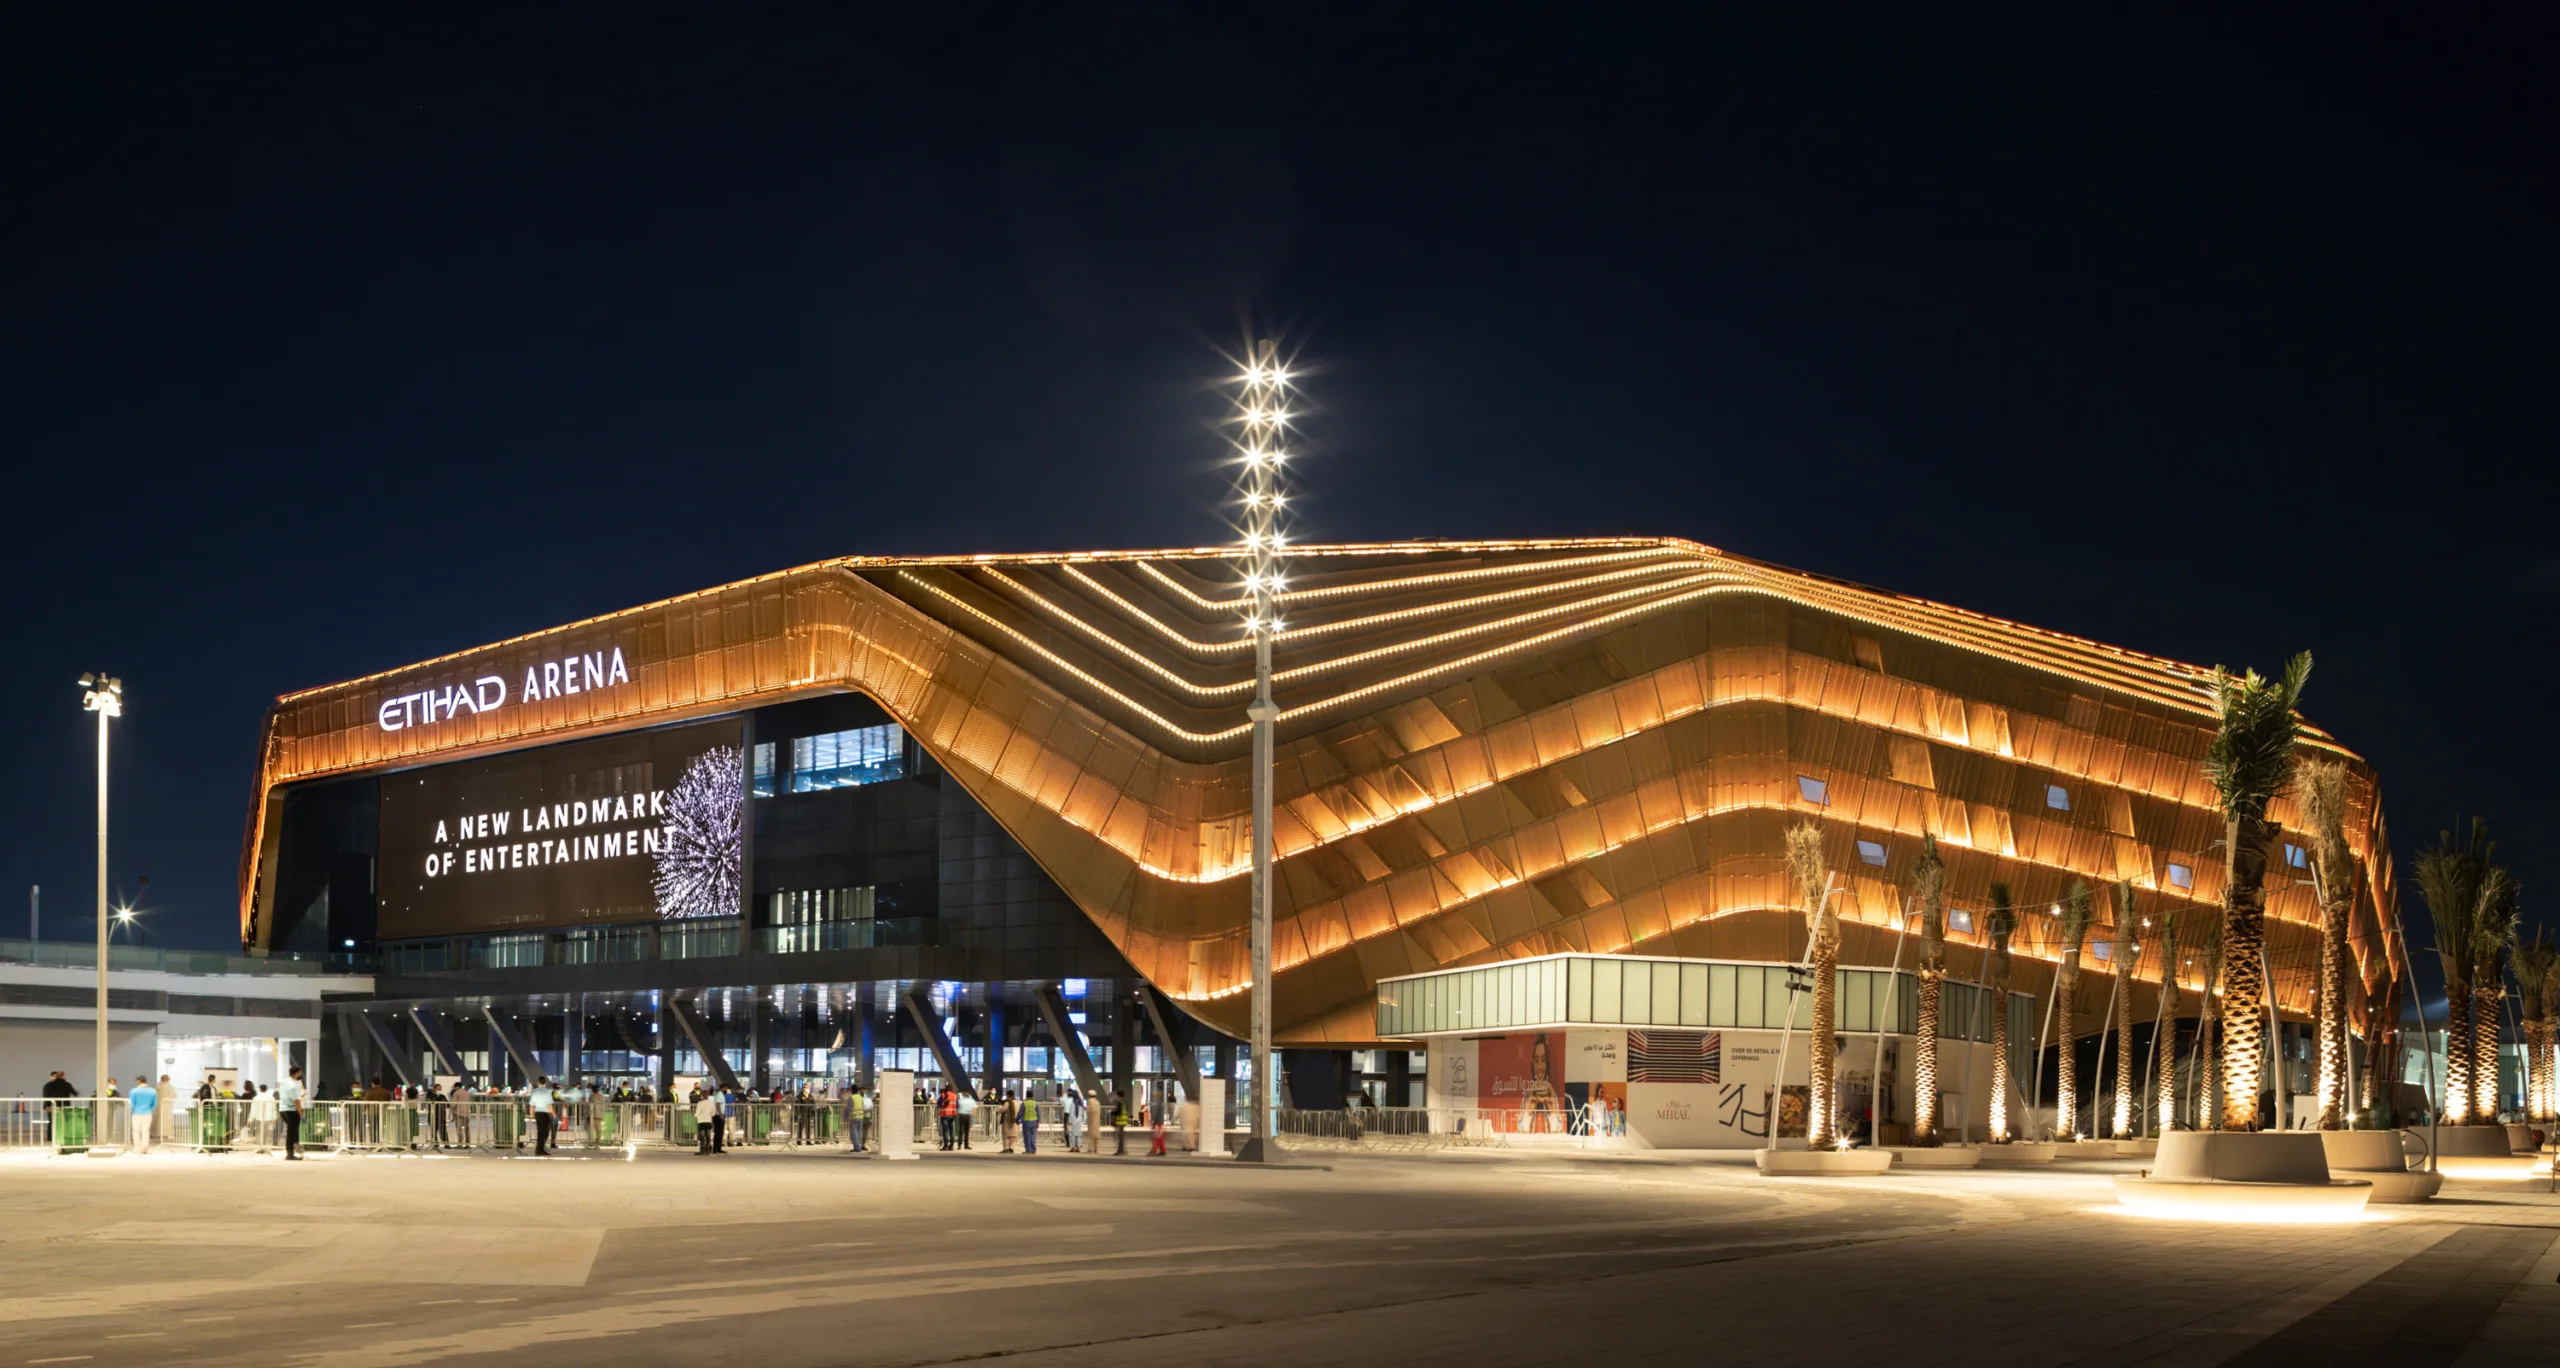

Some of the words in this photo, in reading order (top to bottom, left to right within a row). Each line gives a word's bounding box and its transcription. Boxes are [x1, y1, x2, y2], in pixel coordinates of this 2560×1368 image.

[379, 676, 507, 731] ETIHAD
[522, 646, 629, 703] ARENA
[434, 820, 448, 843] A
[460, 812, 510, 839] NEW
[522, 790, 665, 832] LANDMARK
[425, 853, 453, 877] OF
[465, 826, 676, 873] ENTERTAINMENT
[1656, 1109, 1691, 1120] MIRAL
